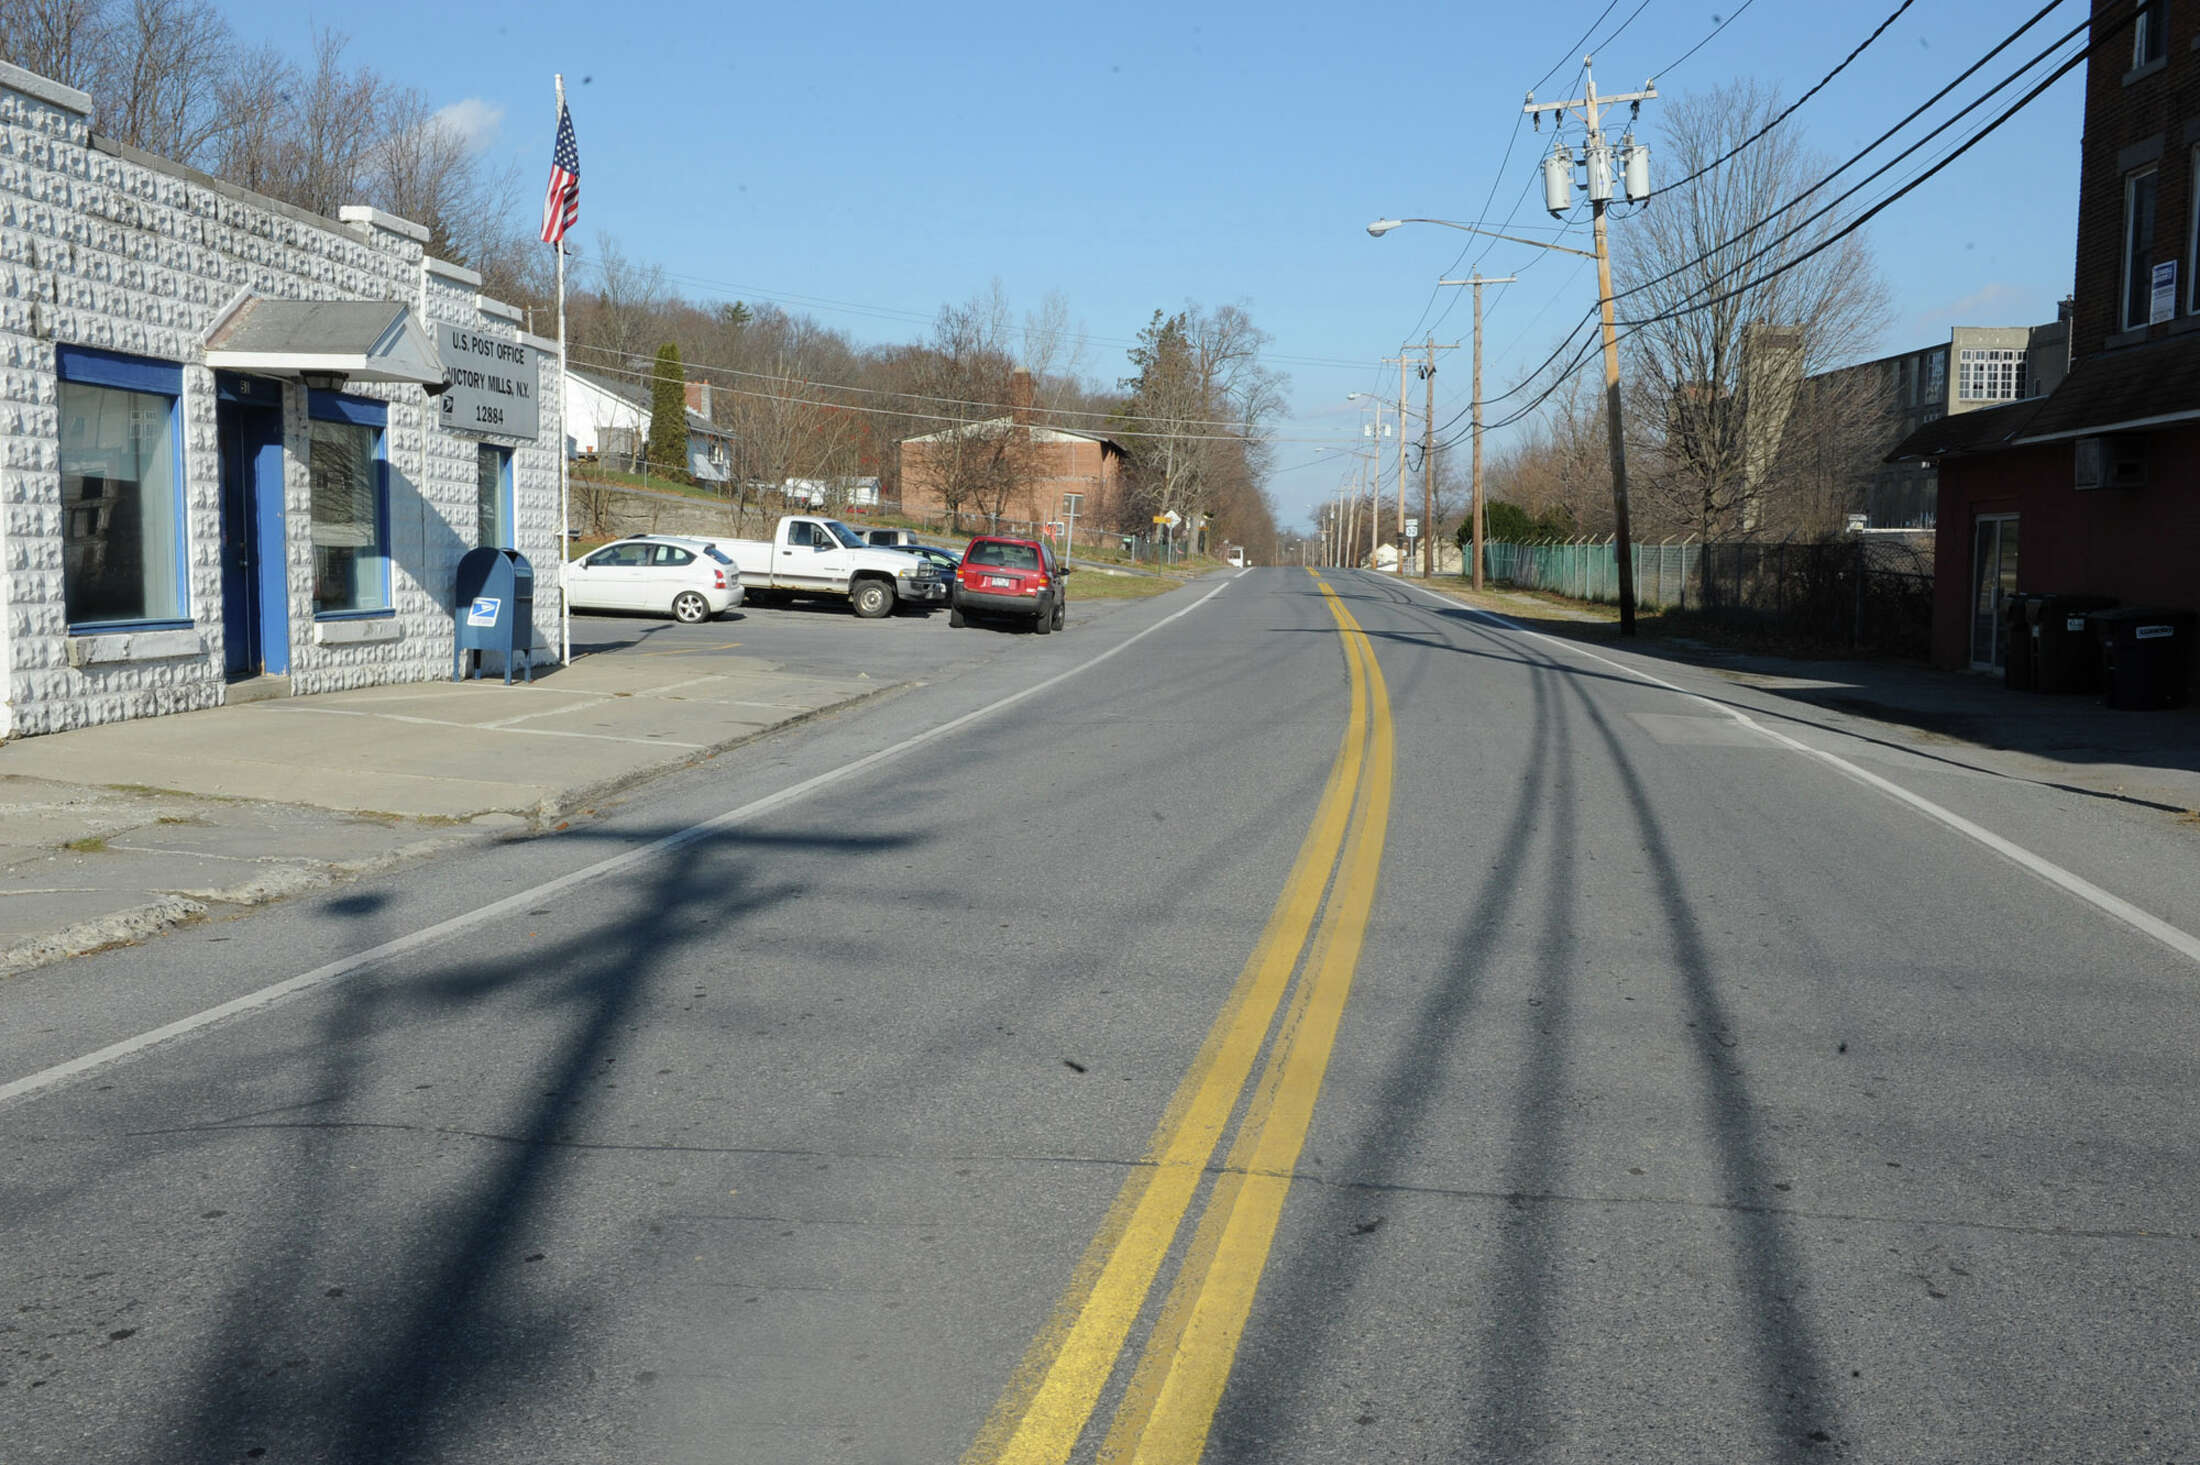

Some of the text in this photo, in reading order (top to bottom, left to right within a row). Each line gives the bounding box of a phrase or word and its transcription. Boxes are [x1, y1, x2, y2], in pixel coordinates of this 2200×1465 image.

[452, 331, 525, 365] U.S. POST OFFICE
[447, 366, 485, 390] VICTORY
[516, 381, 530, 399] N.Y.
[476, 404, 504, 425] 12884
